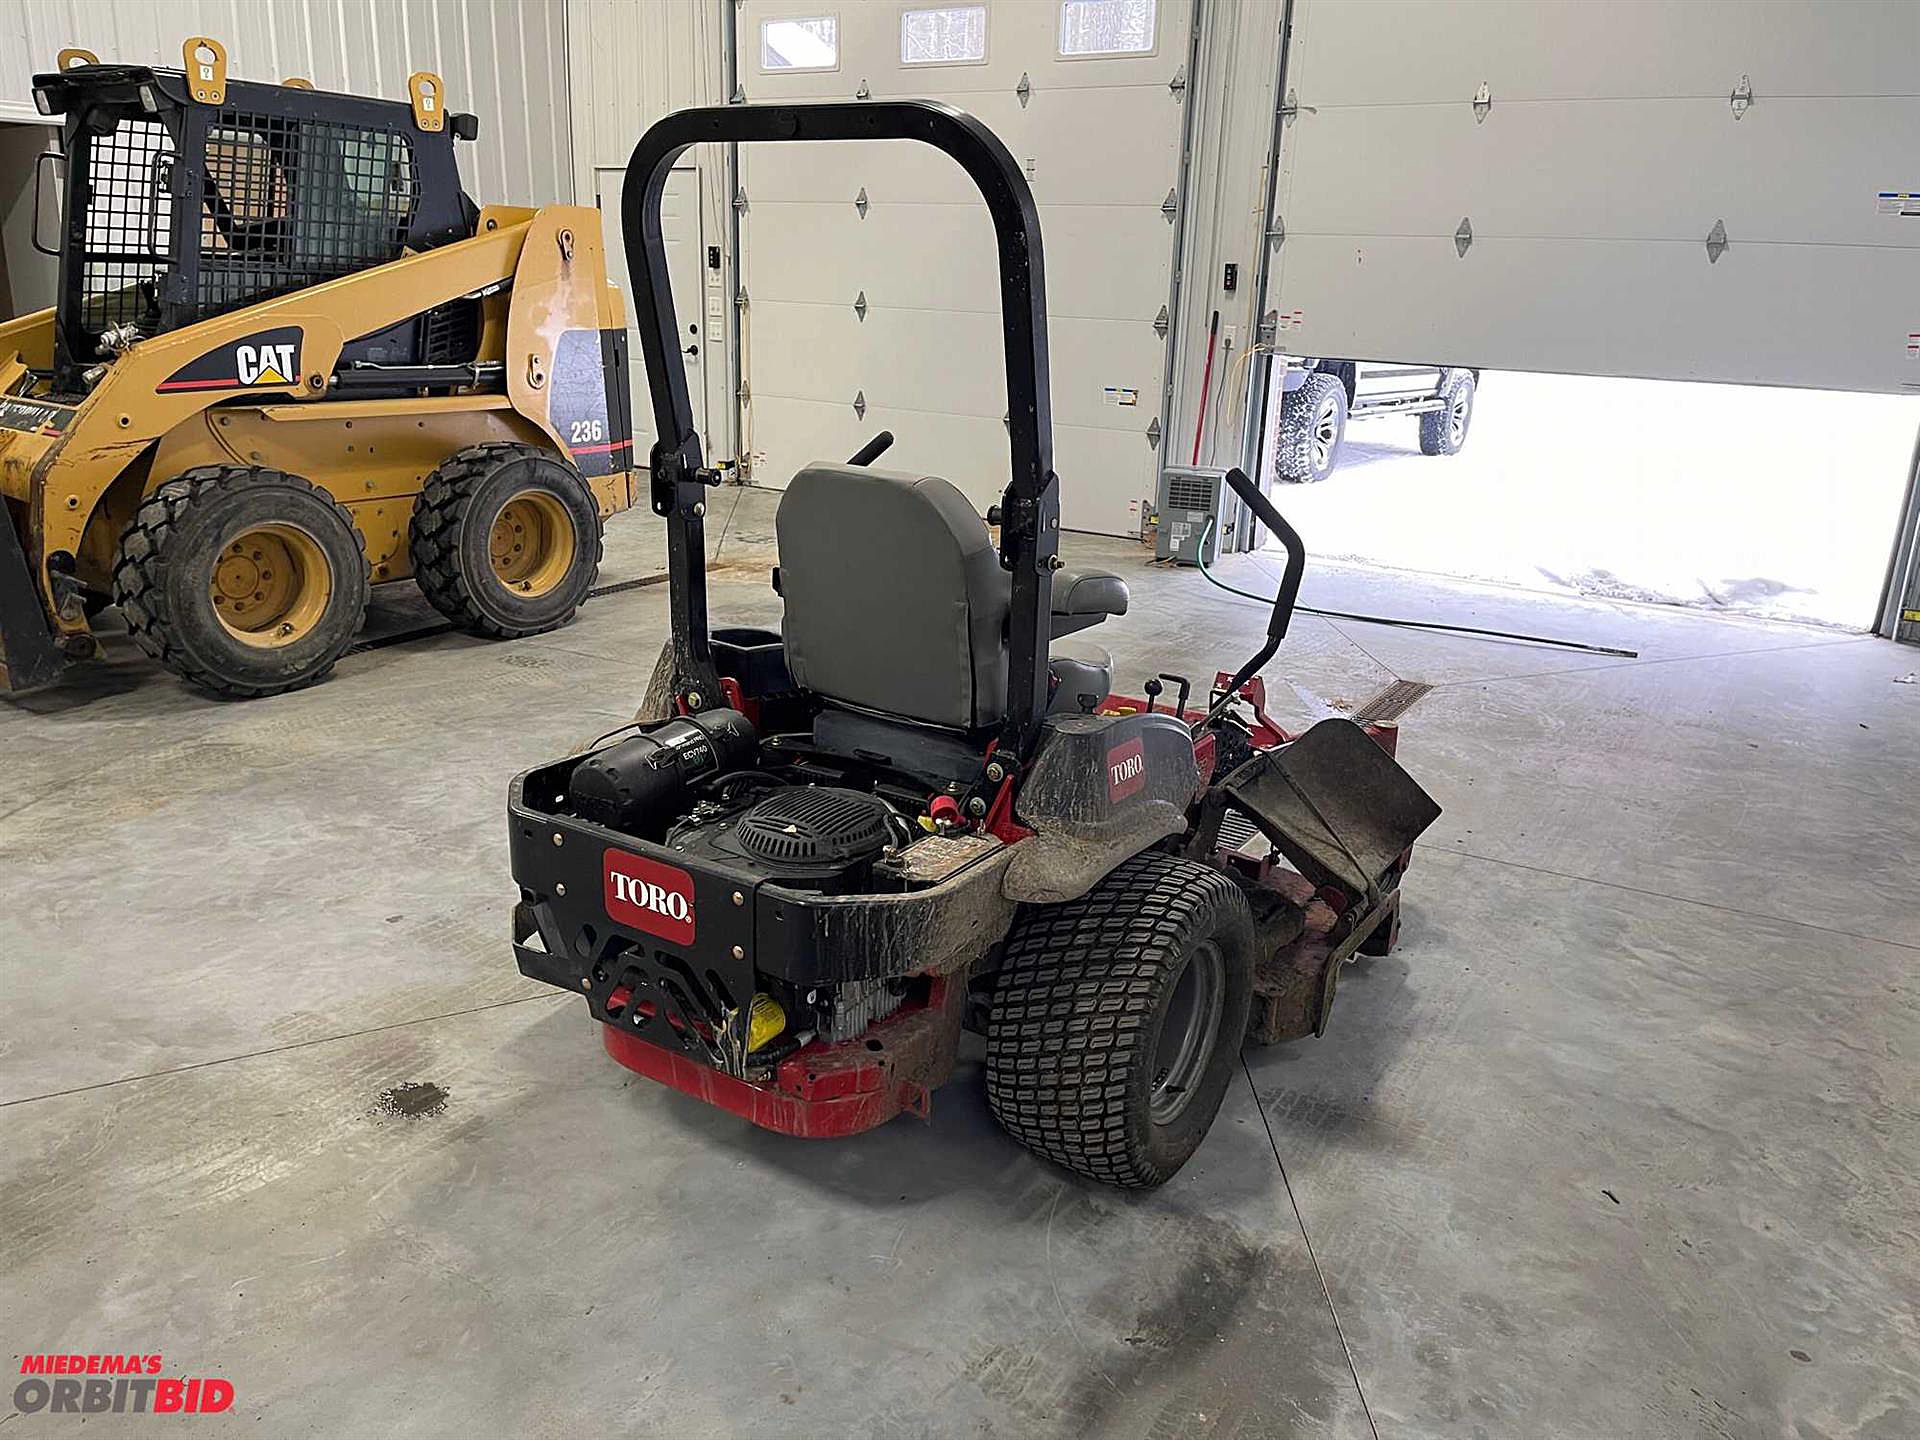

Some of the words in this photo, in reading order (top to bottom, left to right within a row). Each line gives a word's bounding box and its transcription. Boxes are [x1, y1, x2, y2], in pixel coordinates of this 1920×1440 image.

[236, 344, 296, 385] CAT
[571, 420, 602, 443] 236
[1110, 754, 1142, 786] TORO
[610, 871, 688, 920] TORO
